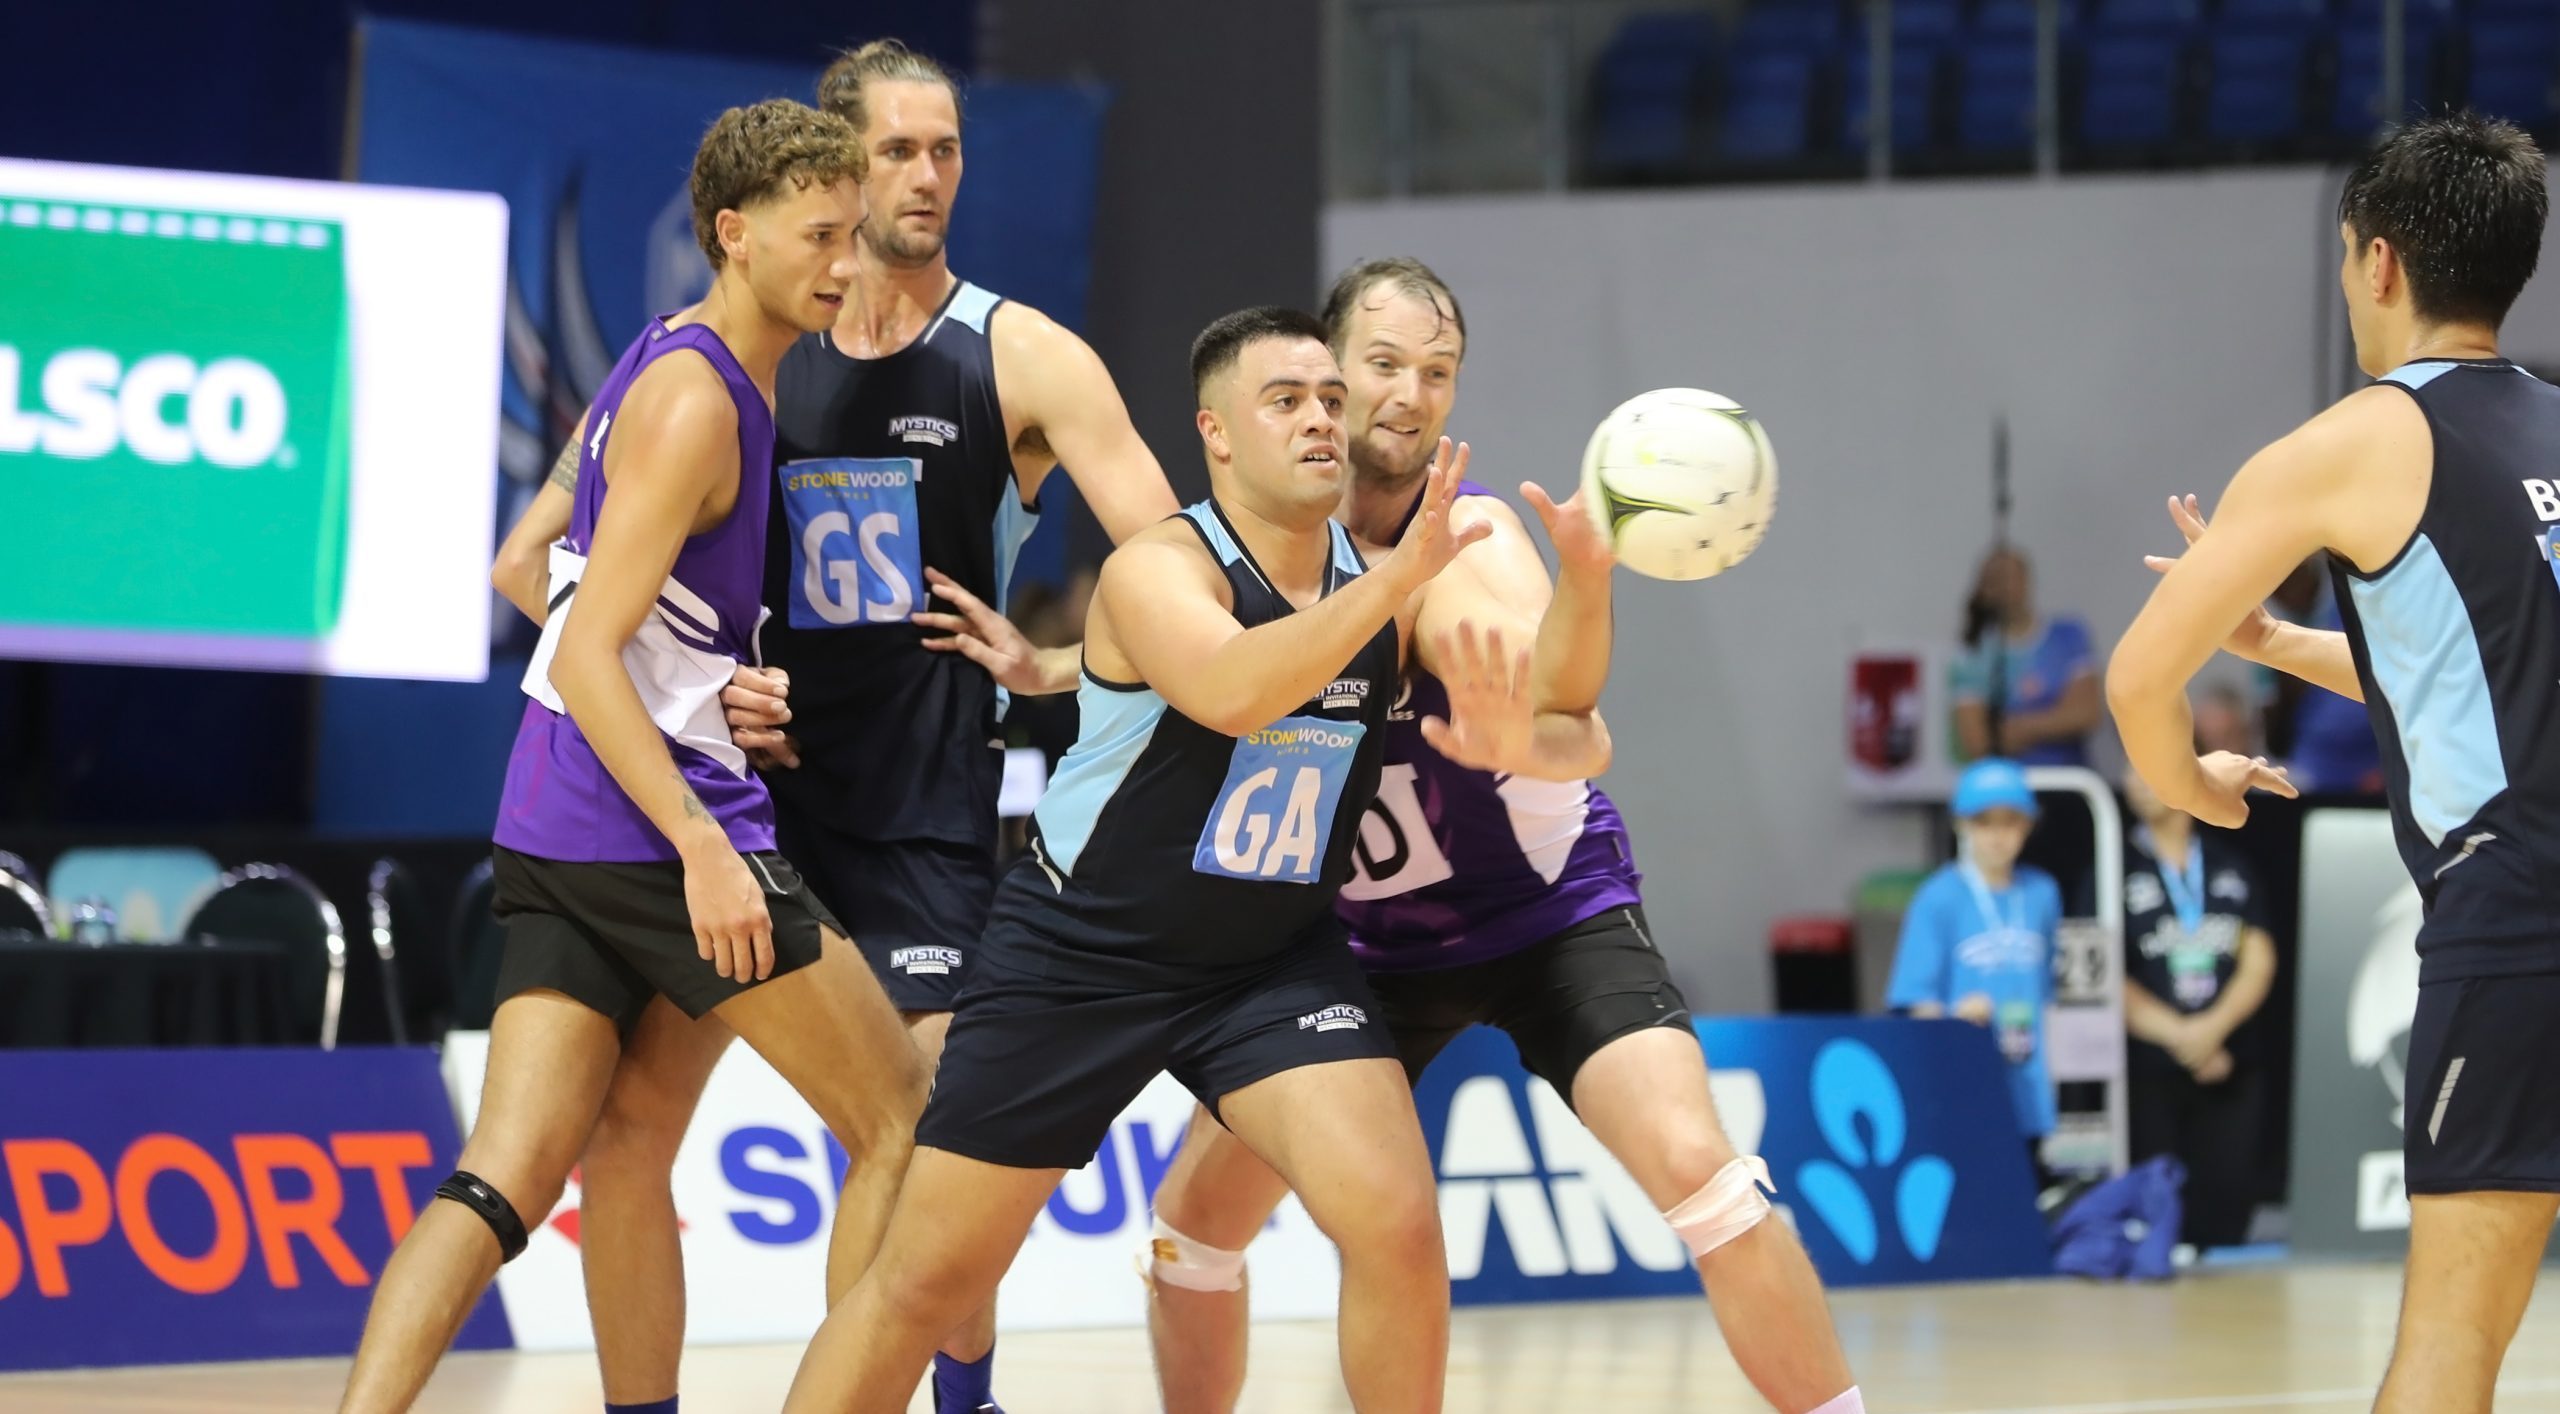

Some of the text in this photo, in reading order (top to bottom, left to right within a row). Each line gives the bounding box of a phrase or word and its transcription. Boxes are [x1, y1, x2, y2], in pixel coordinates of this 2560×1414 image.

[890, 417, 958, 440] MYSTICS
[788, 472, 908, 491] STONEWOOD
[2522, 478, 2560, 522] B
[803, 511, 913, 624] GS
[1247, 728, 1354, 748] STONEWOOD
[1214, 766, 1322, 876] GA
[892, 948, 960, 966] MYSTICS
[1299, 1006, 1365, 1027] MYSTICS
[0, 1131, 434, 1299] PORT
